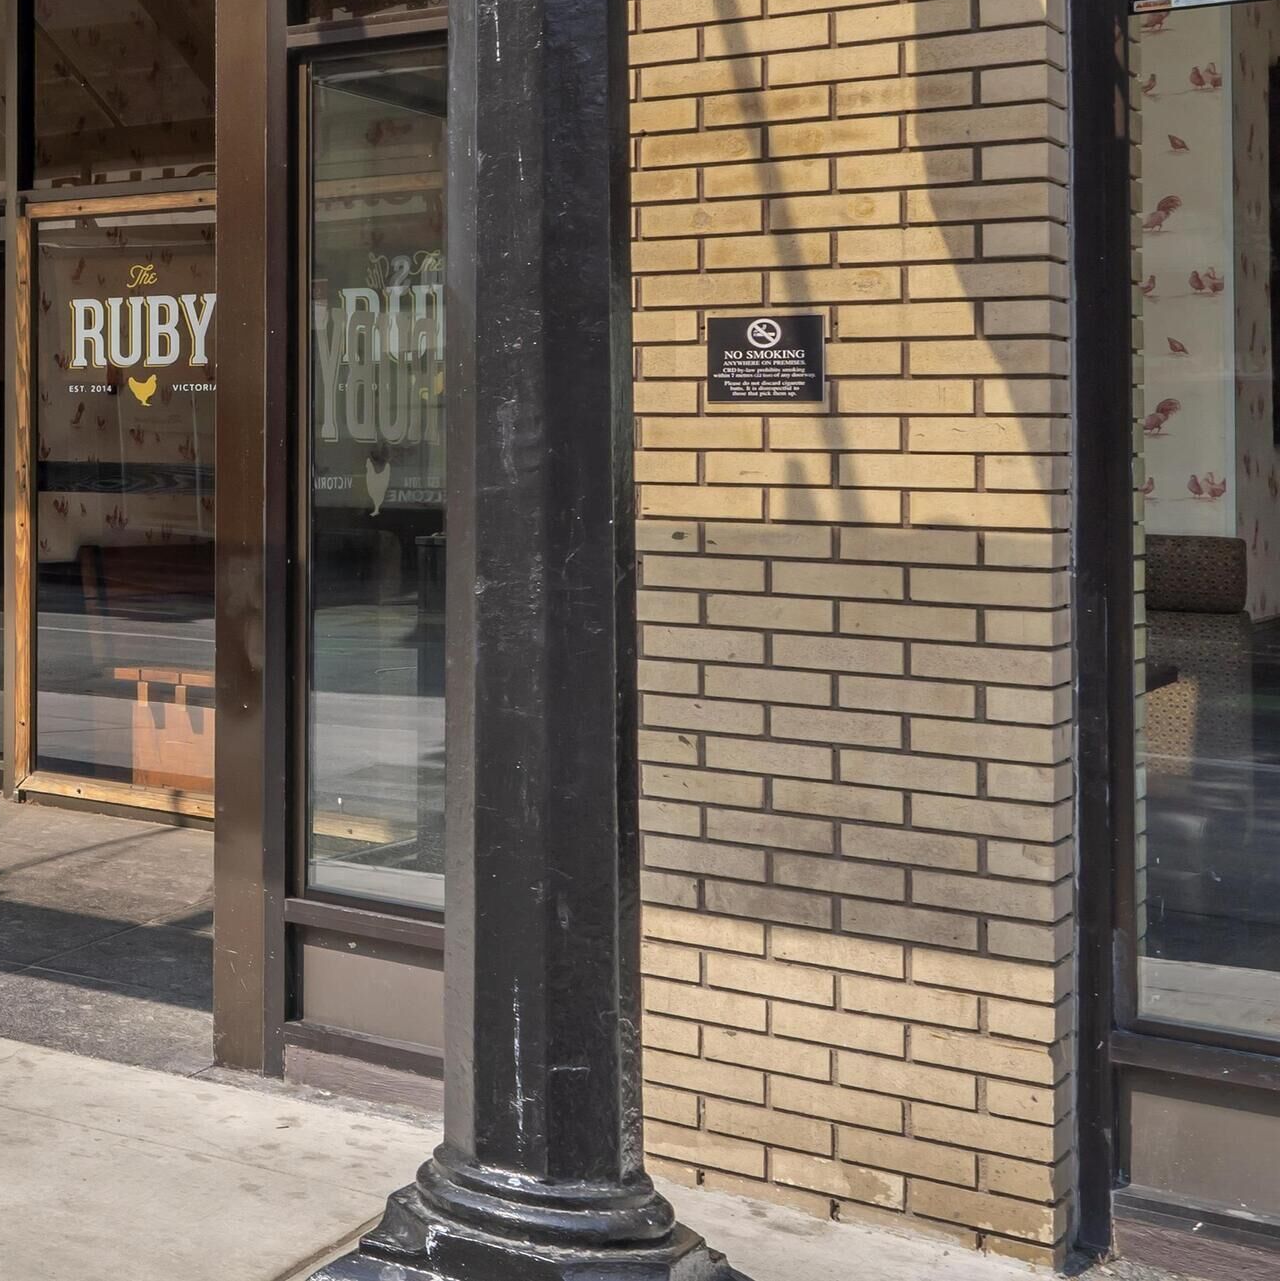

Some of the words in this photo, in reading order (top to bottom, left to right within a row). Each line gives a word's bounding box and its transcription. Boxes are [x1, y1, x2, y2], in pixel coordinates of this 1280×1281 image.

[126, 264, 158, 288] The
[69, 293, 216, 369] RUBY
[724, 351, 742, 359] NO
[746, 350, 805, 359] SMOKING
[69, 385, 87, 393] EST.
[91, 384, 112, 392] 2014
